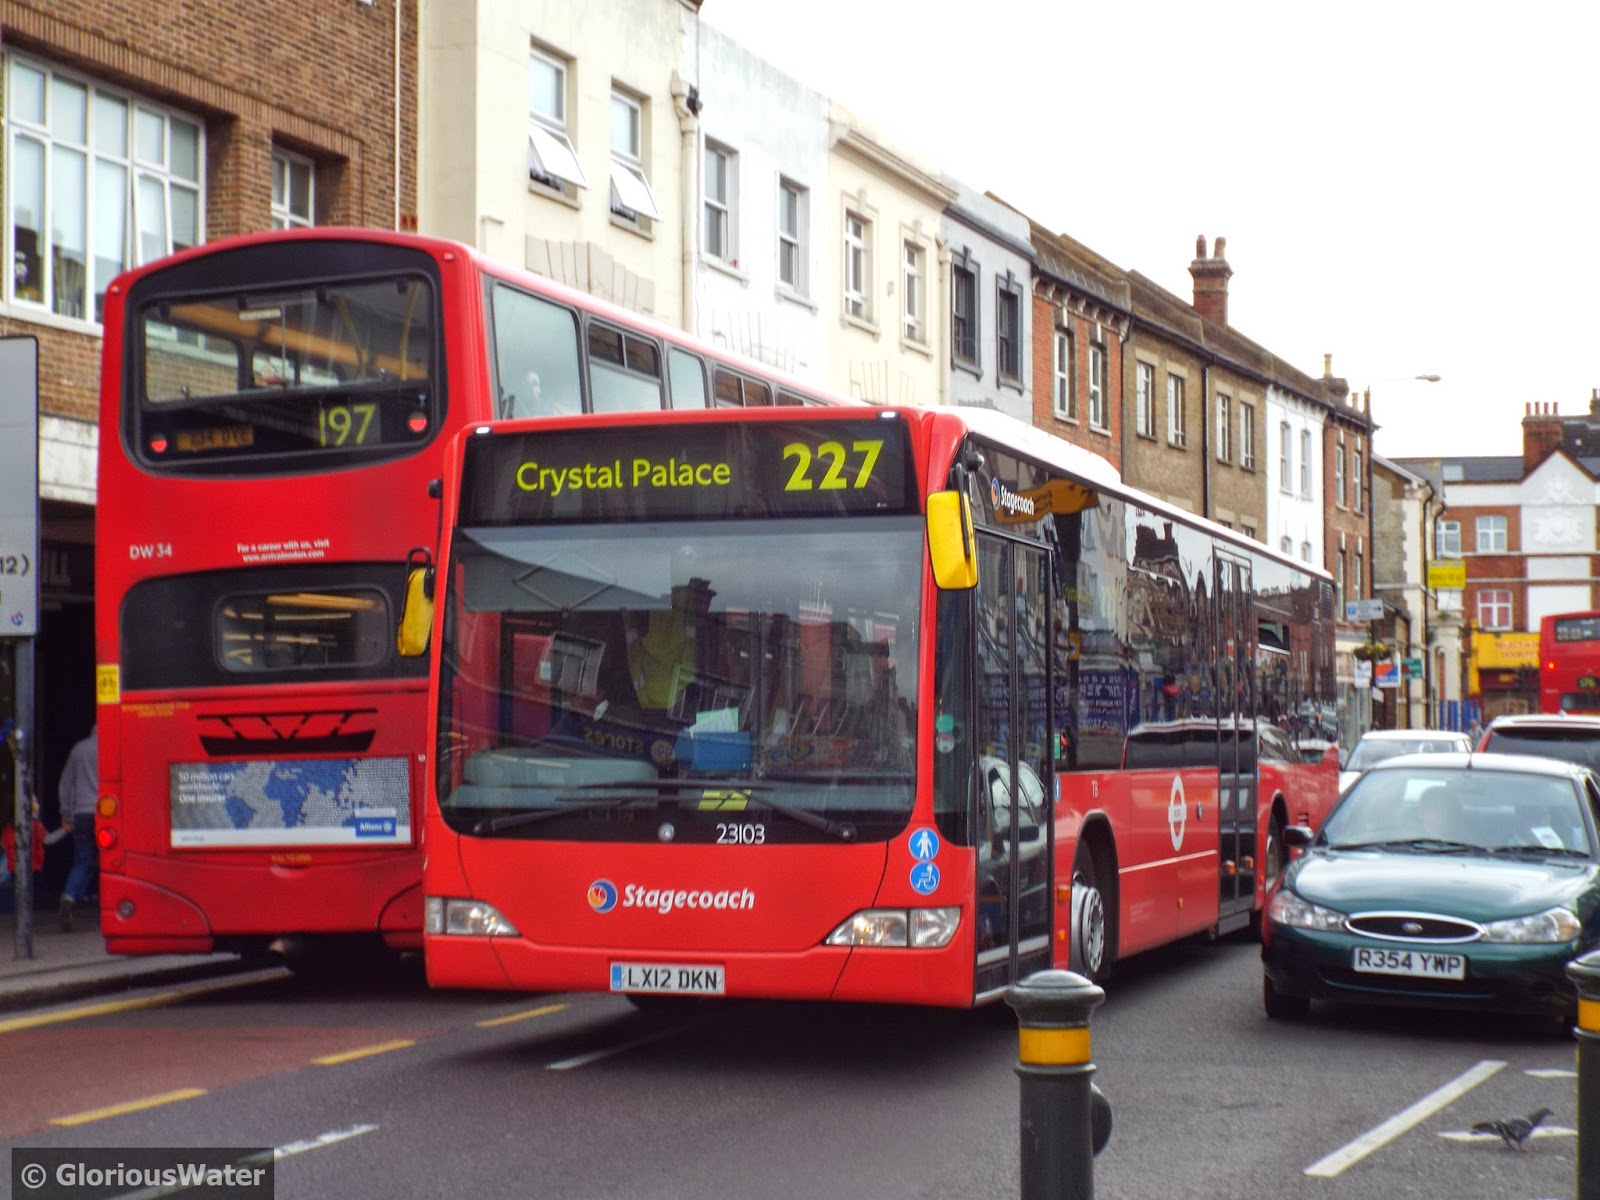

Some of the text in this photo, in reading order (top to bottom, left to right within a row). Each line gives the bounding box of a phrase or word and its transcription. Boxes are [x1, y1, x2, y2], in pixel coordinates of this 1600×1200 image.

[318, 403, 376, 447] 197
[516, 458, 731, 497] Crystal Palace
[783, 440, 884, 492] 227
[1000, 484, 1035, 517] Stagecoach
[129, 543, 173, 560] DW 34
[237, 543, 250, 554] For
[251, 544, 257, 552] a
[257, 542, 282, 552] career
[283, 540, 299, 550] with
[313, 538, 330, 548] visit
[716, 823, 766, 845] 23103
[622, 883, 755, 915] Stagecoach
[1359, 949, 1460, 973] R354 YWP
[628, 967, 717, 991] LX12 DKN
